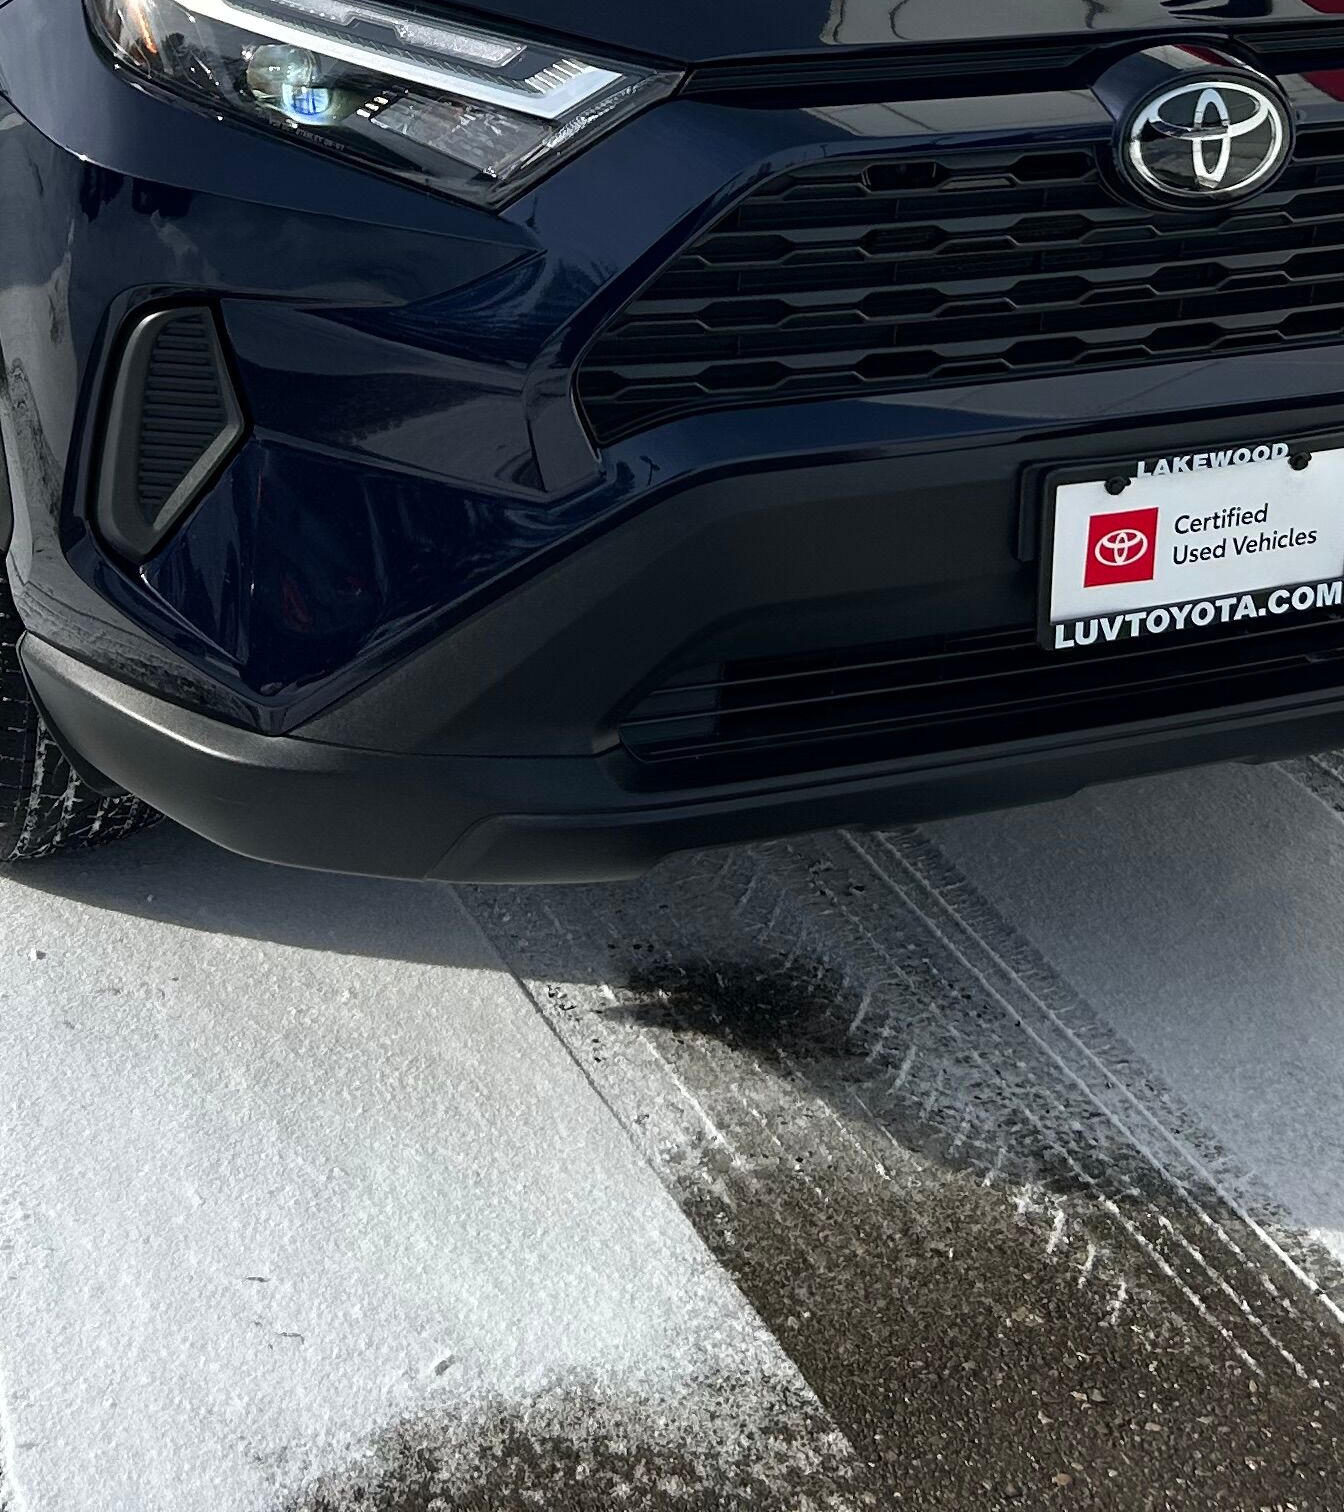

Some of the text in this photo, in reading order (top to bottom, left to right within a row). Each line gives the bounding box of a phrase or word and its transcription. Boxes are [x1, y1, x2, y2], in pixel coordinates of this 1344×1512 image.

[1136, 442, 1290, 479] LAKEWOOD
[1174, 503, 1269, 535] Certified
[1173, 528, 1318, 565] Used Vehicles
[1054, 581, 1344, 650] LUVTOYOTA.COM
